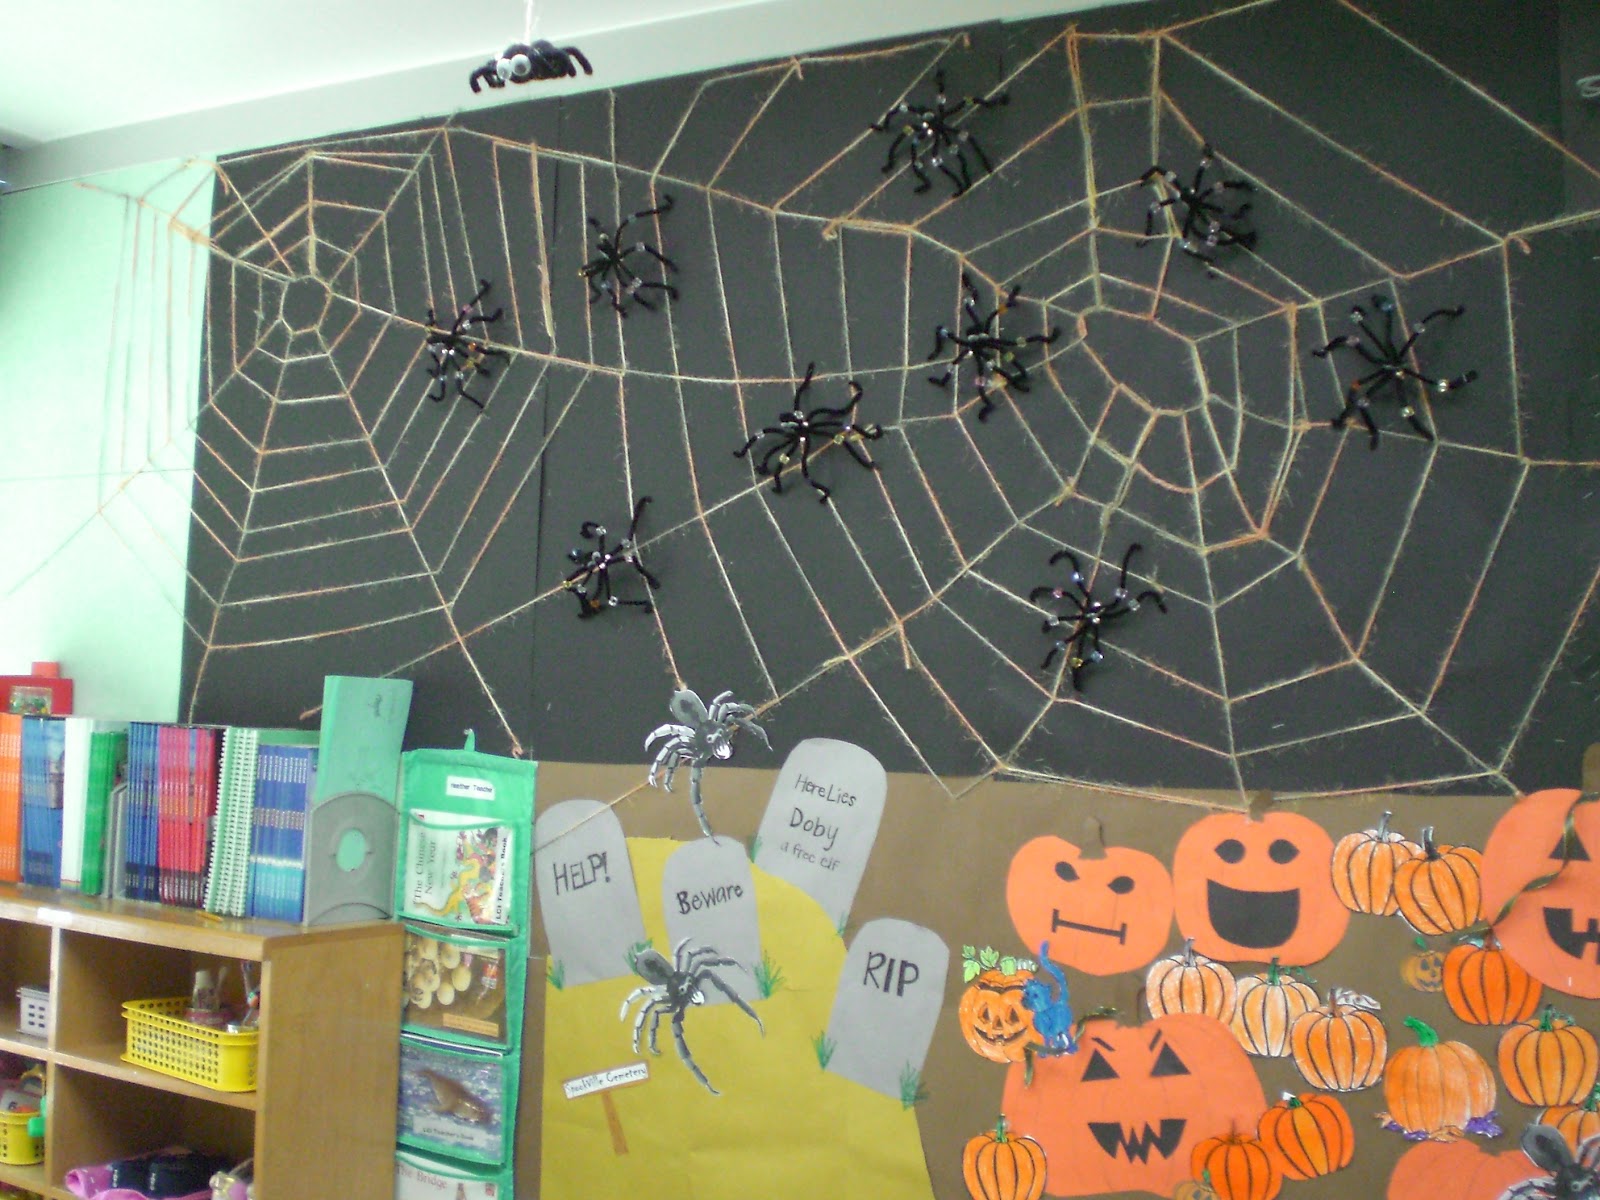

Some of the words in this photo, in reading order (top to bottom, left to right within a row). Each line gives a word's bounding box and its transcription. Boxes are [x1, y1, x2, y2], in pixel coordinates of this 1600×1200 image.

[795, 773, 825, 798] Here
[826, 784, 856, 807] Lies
[789, 807, 839, 852] Doby
[553, 851, 612, 896] HELP!
[676, 884, 744, 915] Beware
[863, 951, 920, 997] RIP
